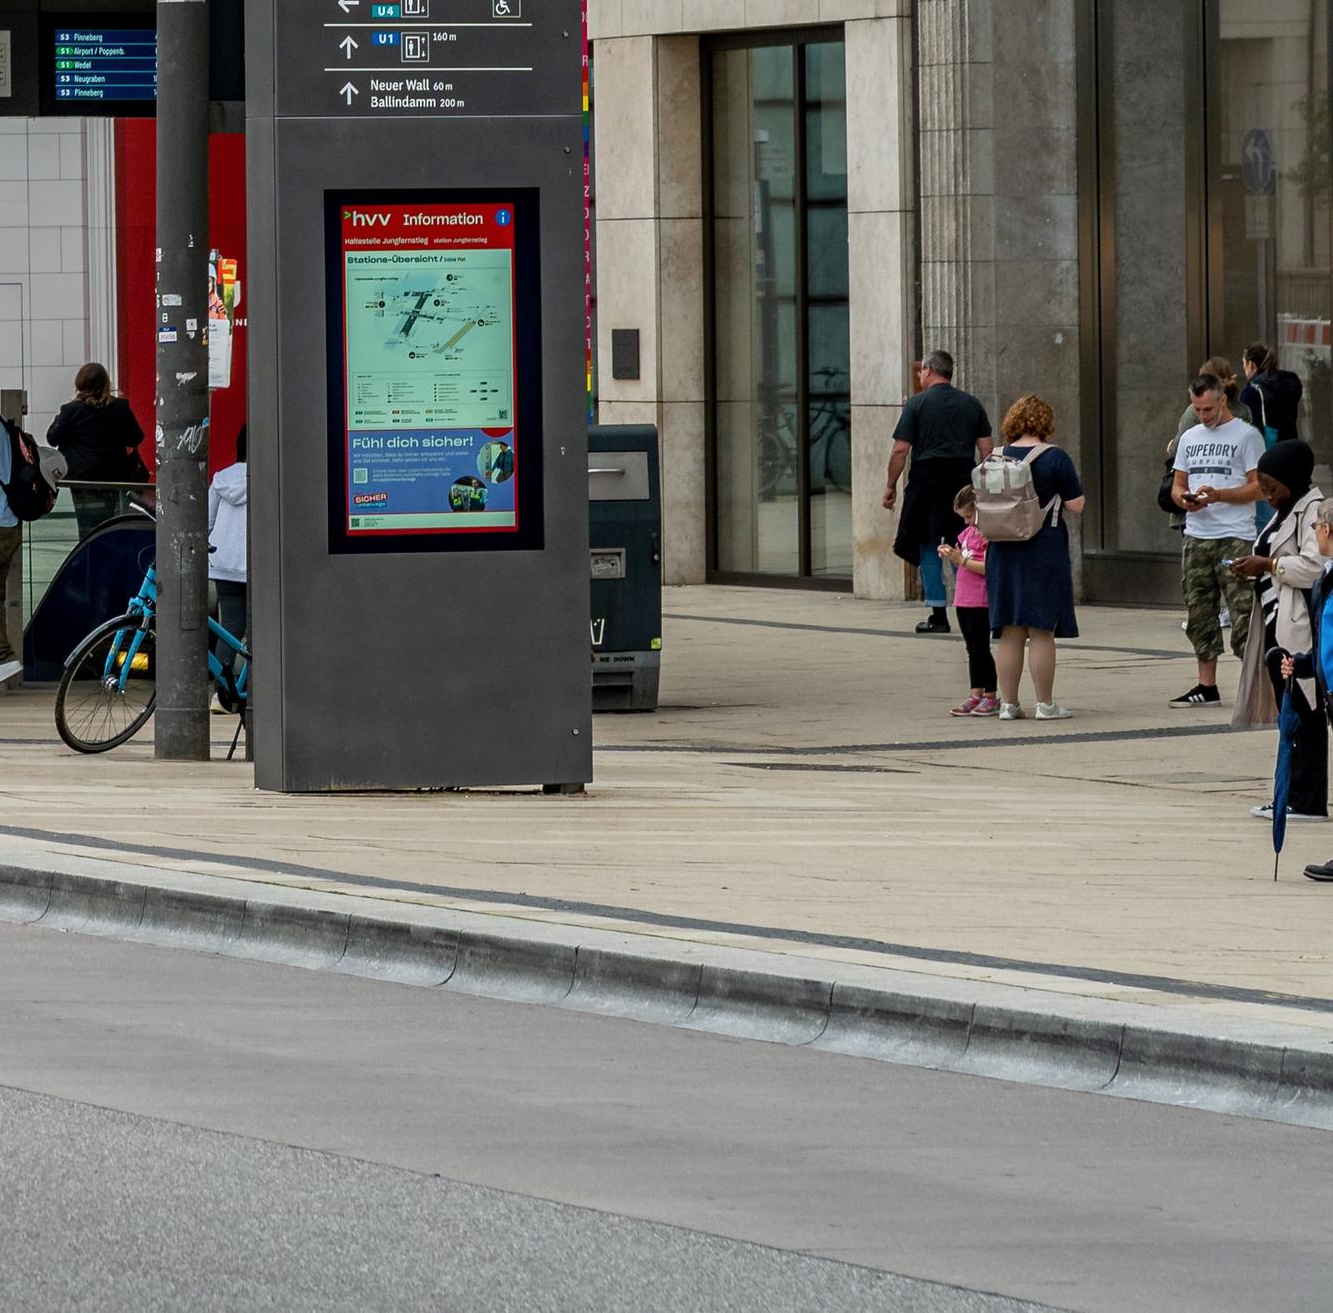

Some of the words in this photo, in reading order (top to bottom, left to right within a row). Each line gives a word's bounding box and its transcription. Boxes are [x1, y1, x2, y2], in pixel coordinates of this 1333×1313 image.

[377, 7, 394, 15] U4
[74, 33, 102, 42] Pinneberg
[379, 34, 393, 43] U1
[433, 32, 448, 41] 160
[74, 47, 93, 56] Airport
[99, 47, 125, 56] Poppenb.
[74, 61, 91, 69] Wedel
[74, 75, 105, 84] Neugraben
[371, 79, 403, 92] Neuer
[405, 79, 430, 92] Wall
[433, 83, 444, 91] 60
[75, 89, 103, 98] Pinneberg
[371, 96, 436, 108] Ballindamm
[440, 99, 455, 108] 200
[353, 210, 391, 226] hvv
[403, 212, 483, 226] Information
[382, 237, 428, 246] Jungfernstieg
[347, 255, 438, 264] Stations-Übersicht
[353, 437, 383, 449] Fühl
[387, 437, 419, 448] dich
[422, 436, 473, 447] sicher!
[1185, 443, 1238, 458] SUPERDRY
[355, 494, 387, 503] SICHER
